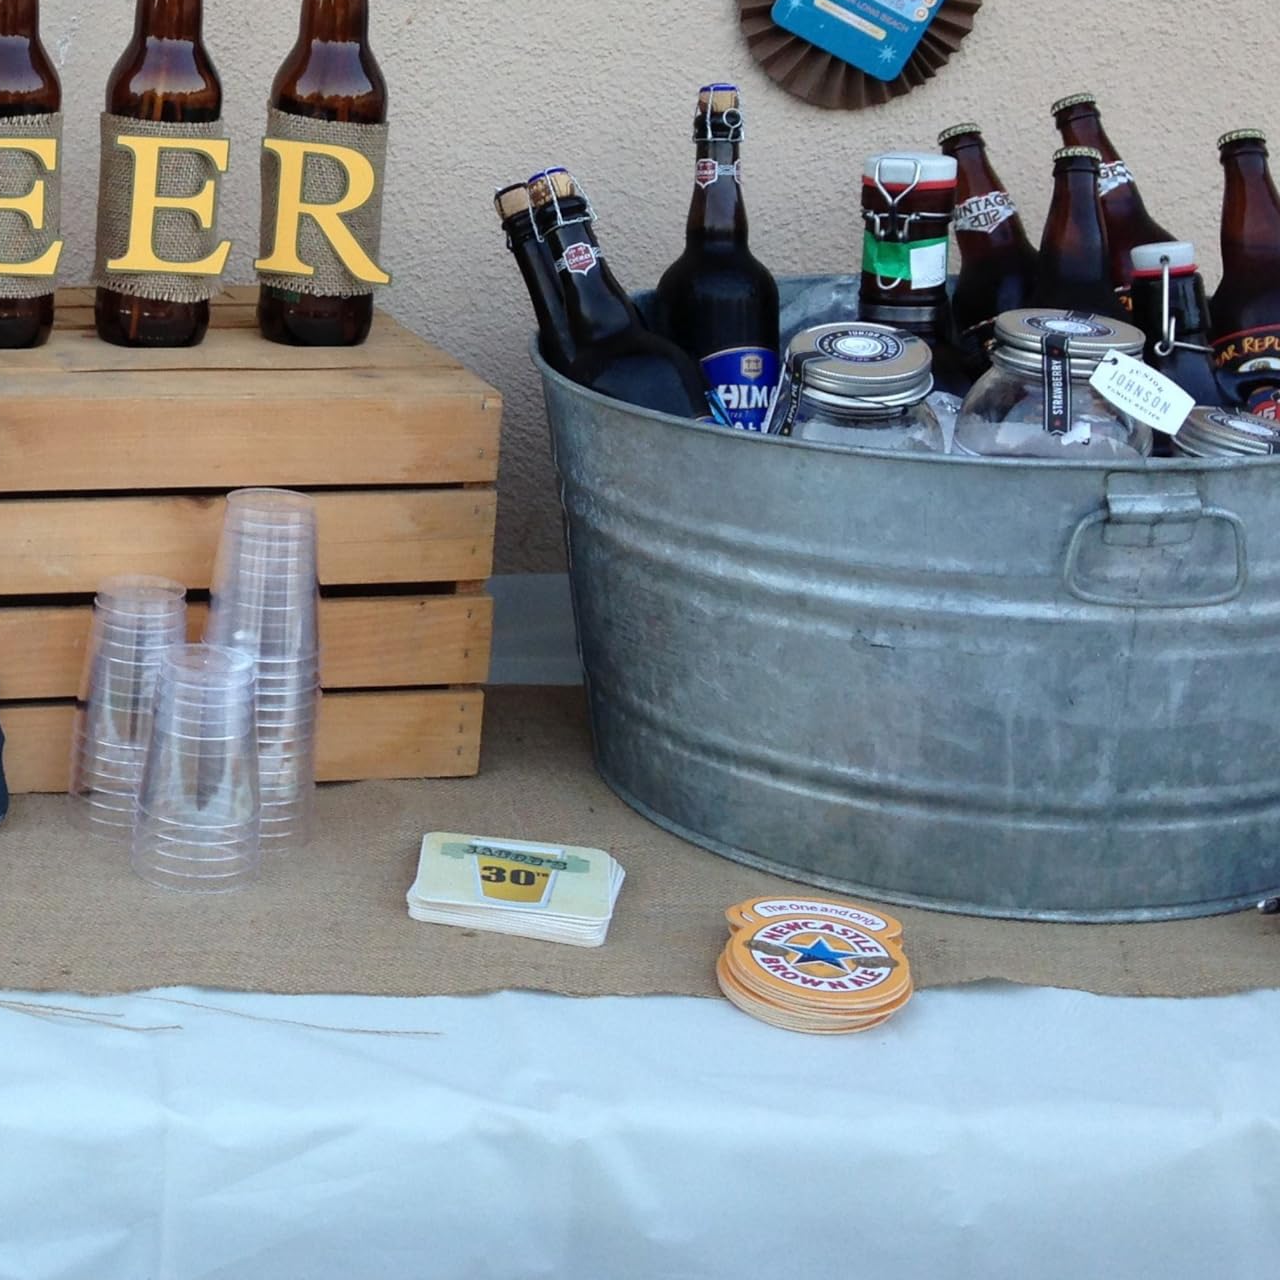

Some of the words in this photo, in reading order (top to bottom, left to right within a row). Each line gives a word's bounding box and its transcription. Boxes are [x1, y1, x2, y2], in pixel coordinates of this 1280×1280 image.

[968, 208, 1000, 228] 2012
[1051, 359, 1064, 415] STRAWBERRY
[1109, 370, 1172, 415] JOHNSON
[761, 903, 788, 915] The
[788, 903, 818, 912] One
[820, 906, 849, 918] and
[848, 912, 883, 928] Only
[761, 921, 883, 955] NEWCASTLE
[760, 957, 850, 991] BROWN
[850, 969, 883, 988] ALE
